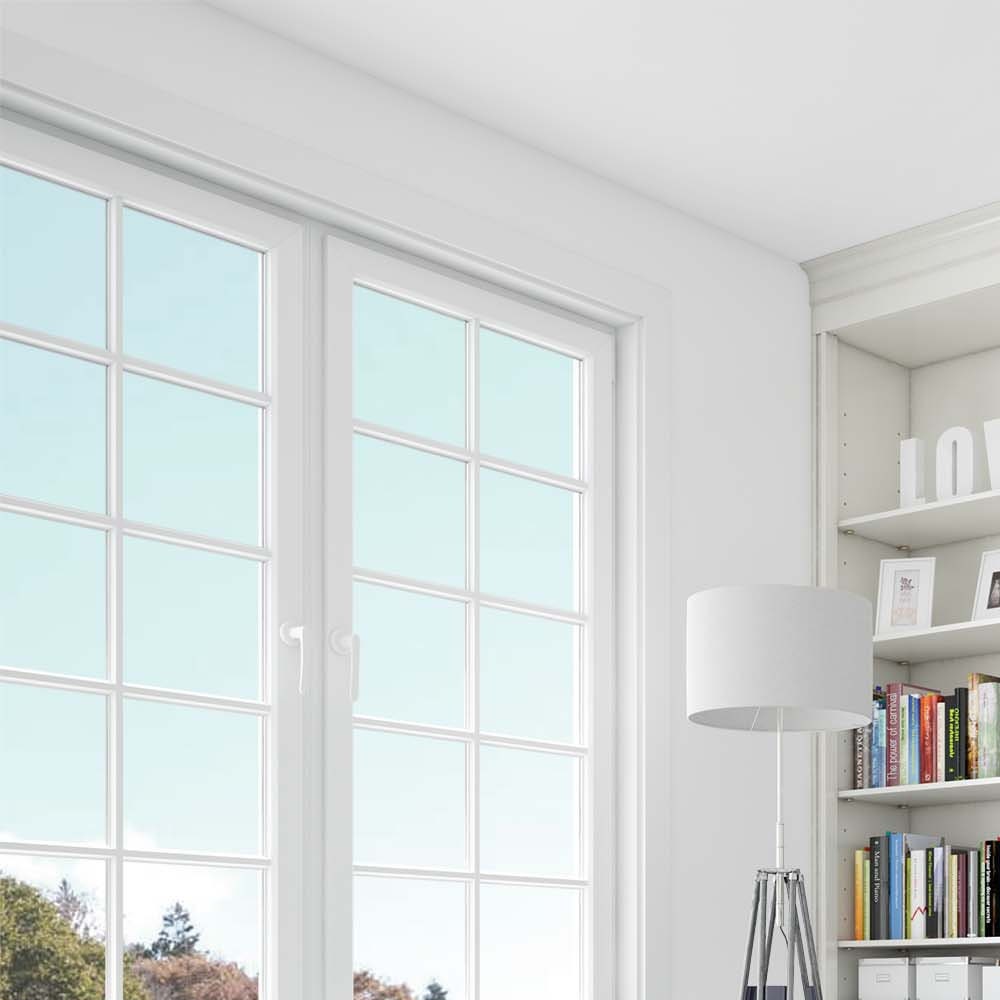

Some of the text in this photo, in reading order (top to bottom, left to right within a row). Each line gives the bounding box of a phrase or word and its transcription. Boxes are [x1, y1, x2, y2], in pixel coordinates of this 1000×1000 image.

[886, 692, 899, 781] The power of carnival
